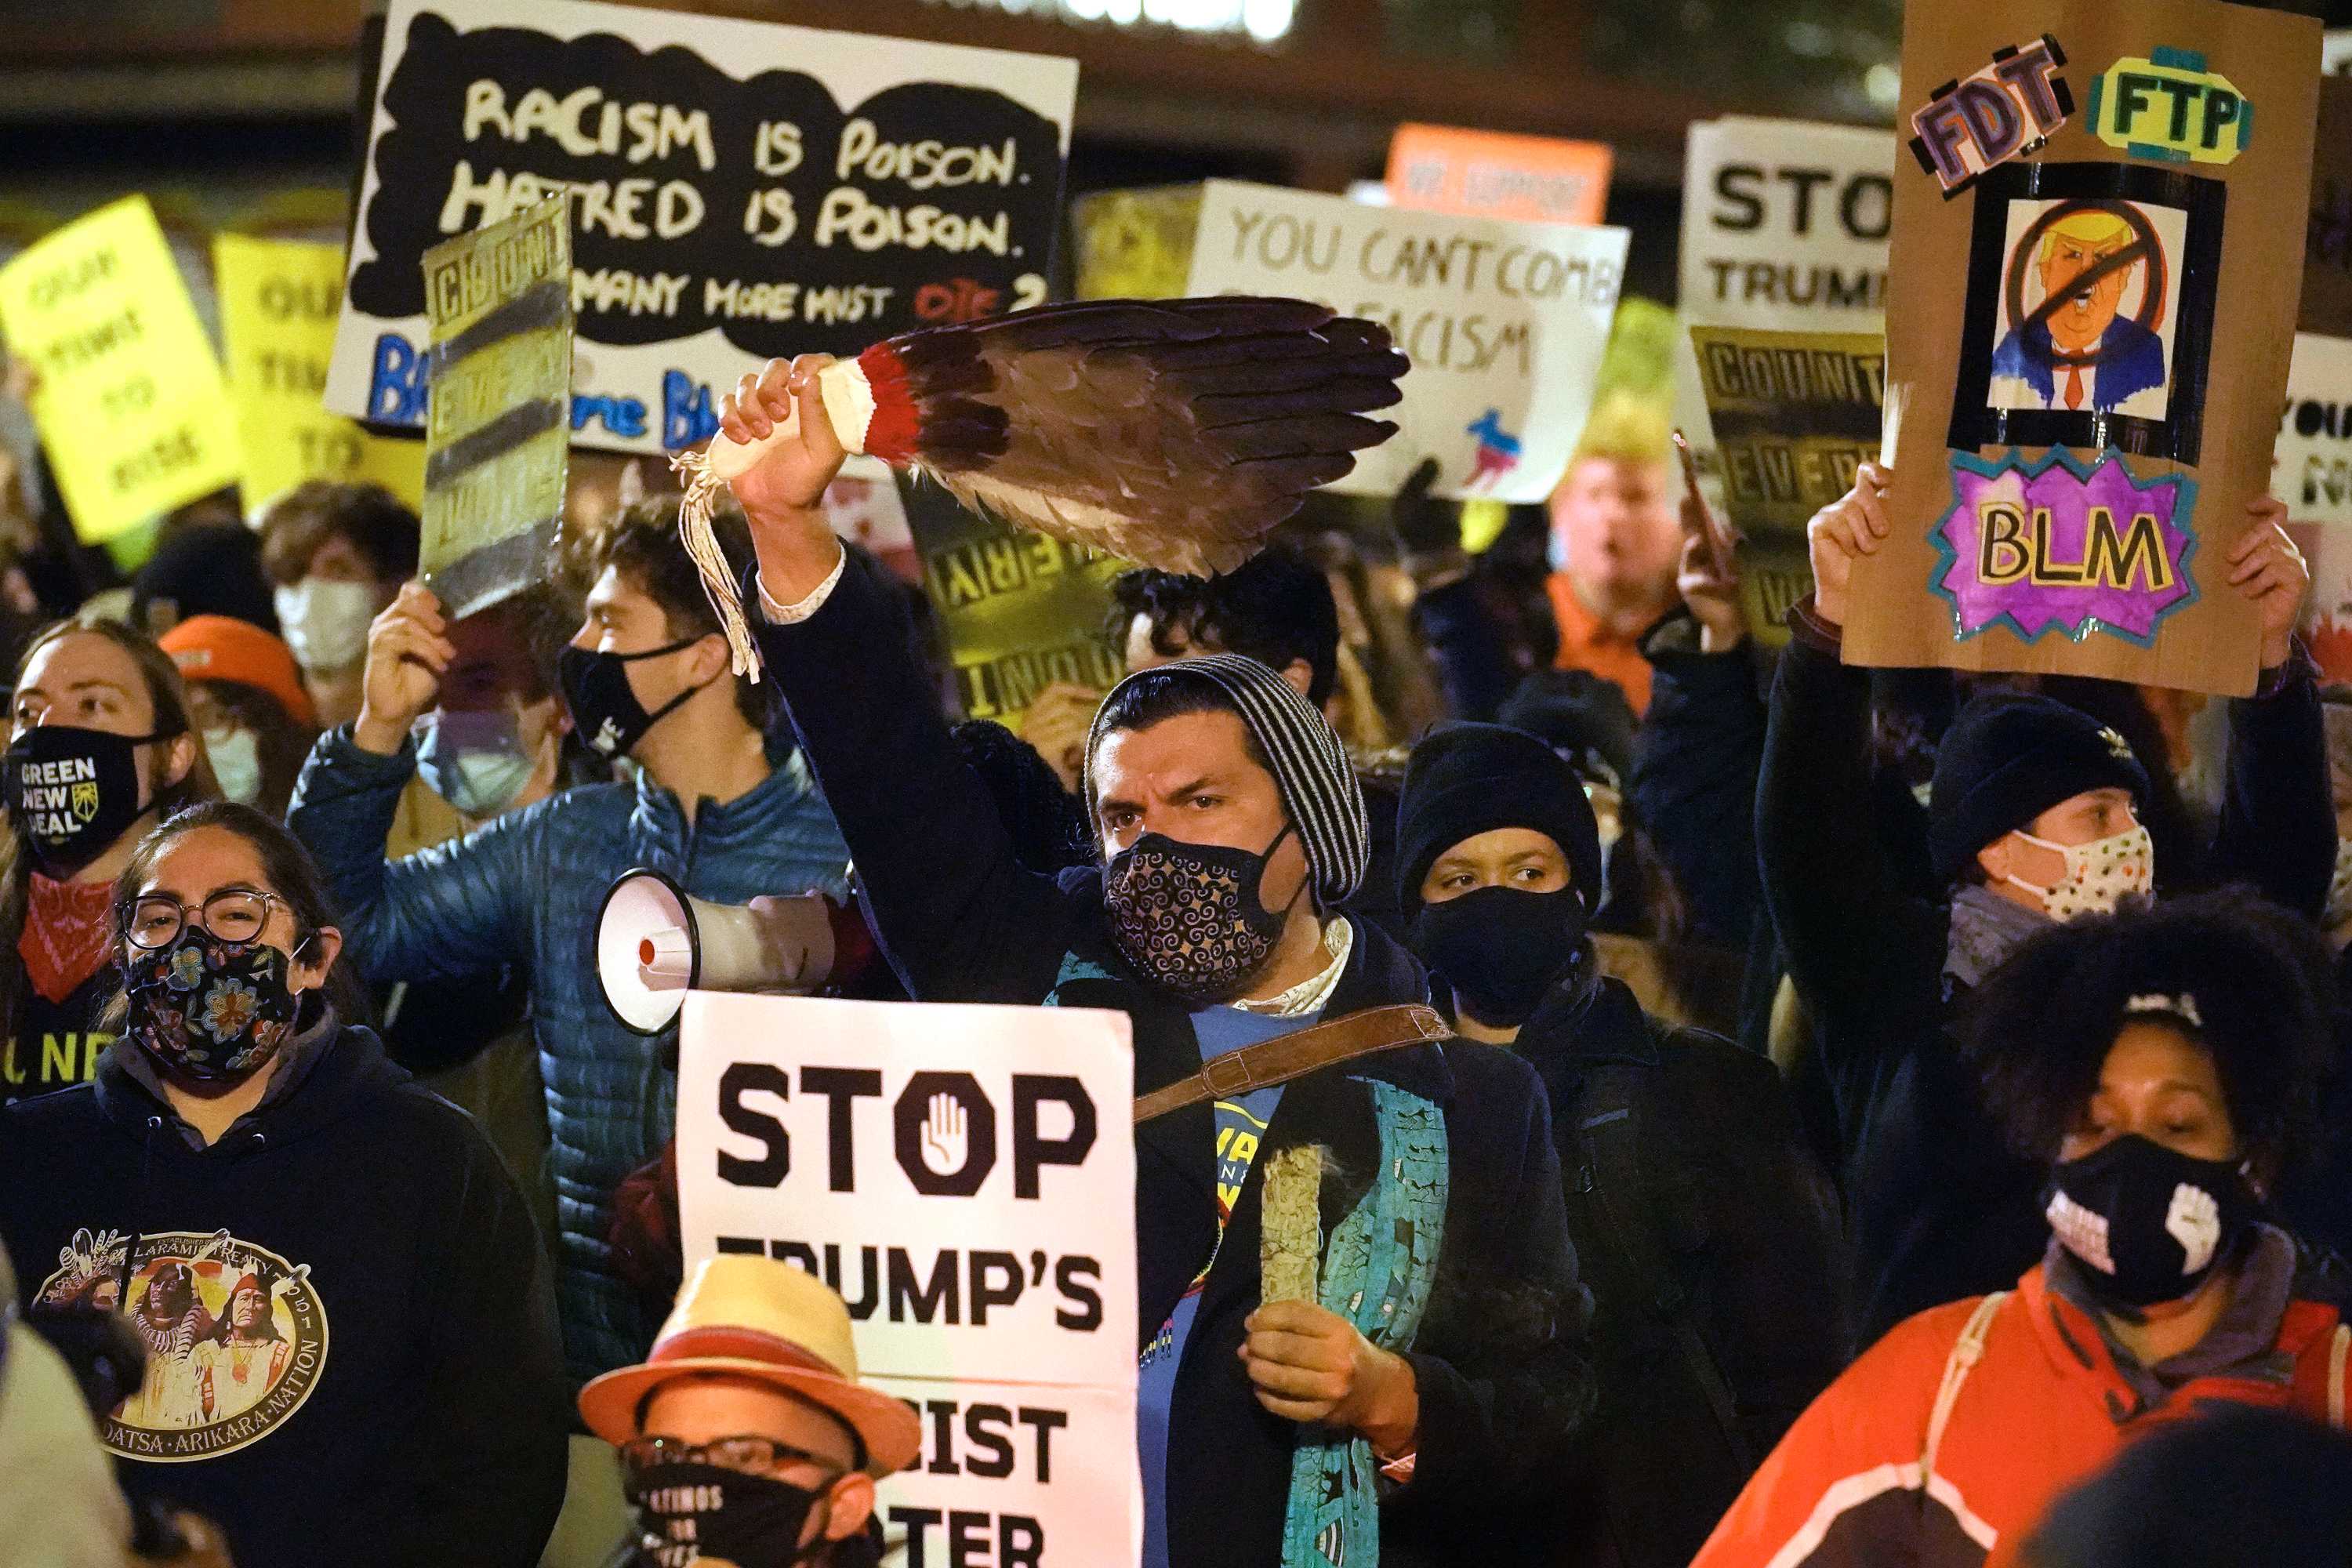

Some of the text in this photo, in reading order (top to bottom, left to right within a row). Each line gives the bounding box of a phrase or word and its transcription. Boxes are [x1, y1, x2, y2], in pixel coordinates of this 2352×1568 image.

[463, 79, 1032, 190] RACISM IS POISON.
[1918, 45, 2062, 183] FDT
[2114, 72, 2240, 149] FTP
[743, 187, 800, 247] IS
[815, 185, 1024, 257] POISON.
[1711, 162, 1894, 240] STO
[1230, 206, 1342, 274] YOU
[257, 274, 342, 327] OU
[572, 267, 691, 315] MANY
[706, 277, 796, 320] MORE
[804, 281, 897, 325] MUST
[1706, 257, 1888, 308] TRUM
[1706, 341, 1884, 406] COUNT
[1979, 503, 2174, 593] BLM
[21, 756, 96, 785] GREEN
[22, 786, 67, 811] NEW
[717, 1062, 1098, 1200] STOP
[717, 1236, 1104, 1332] UMP'S
[175, 1410, 270, 1453] ARIKARA
[269, 1338, 318, 1414] NATION
